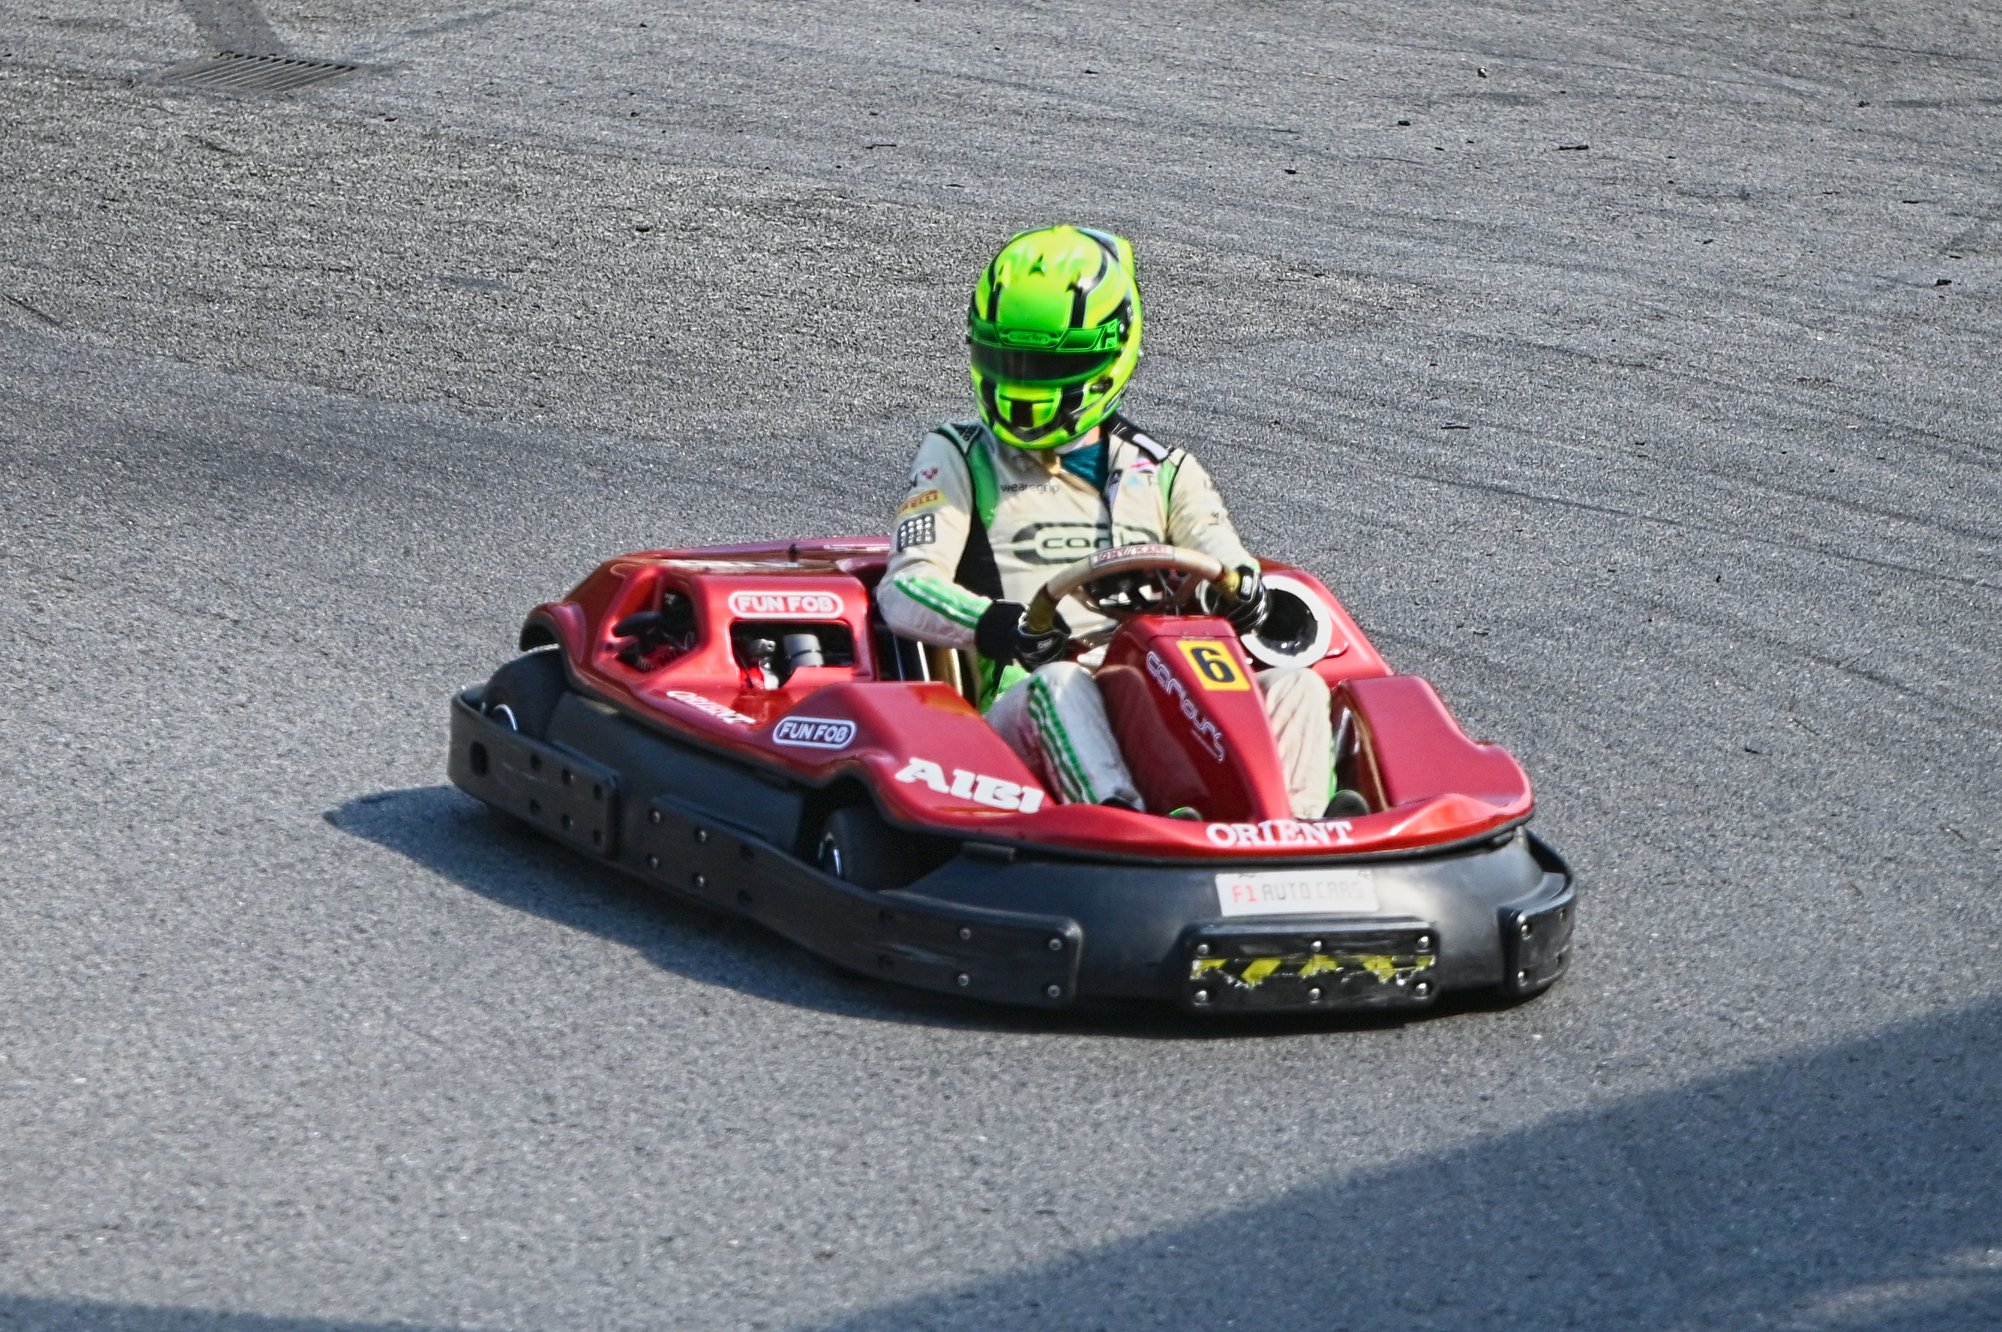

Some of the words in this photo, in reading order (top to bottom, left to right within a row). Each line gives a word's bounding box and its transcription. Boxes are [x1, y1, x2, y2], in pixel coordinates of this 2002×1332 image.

[737, 596, 785, 612] FUN
[787, 596, 833, 612] FOB
[1191, 646, 1235, 682] 6
[778, 721, 814, 740] FUN
[813, 724, 849, 743] FOB
[895, 757, 1045, 814] AIBI
[1206, 820, 1355, 848] ORIENT
[1231, 884, 1257, 903] F1
[1262, 882, 1312, 901] AUTO
[1316, 880, 1364, 900] CARS
